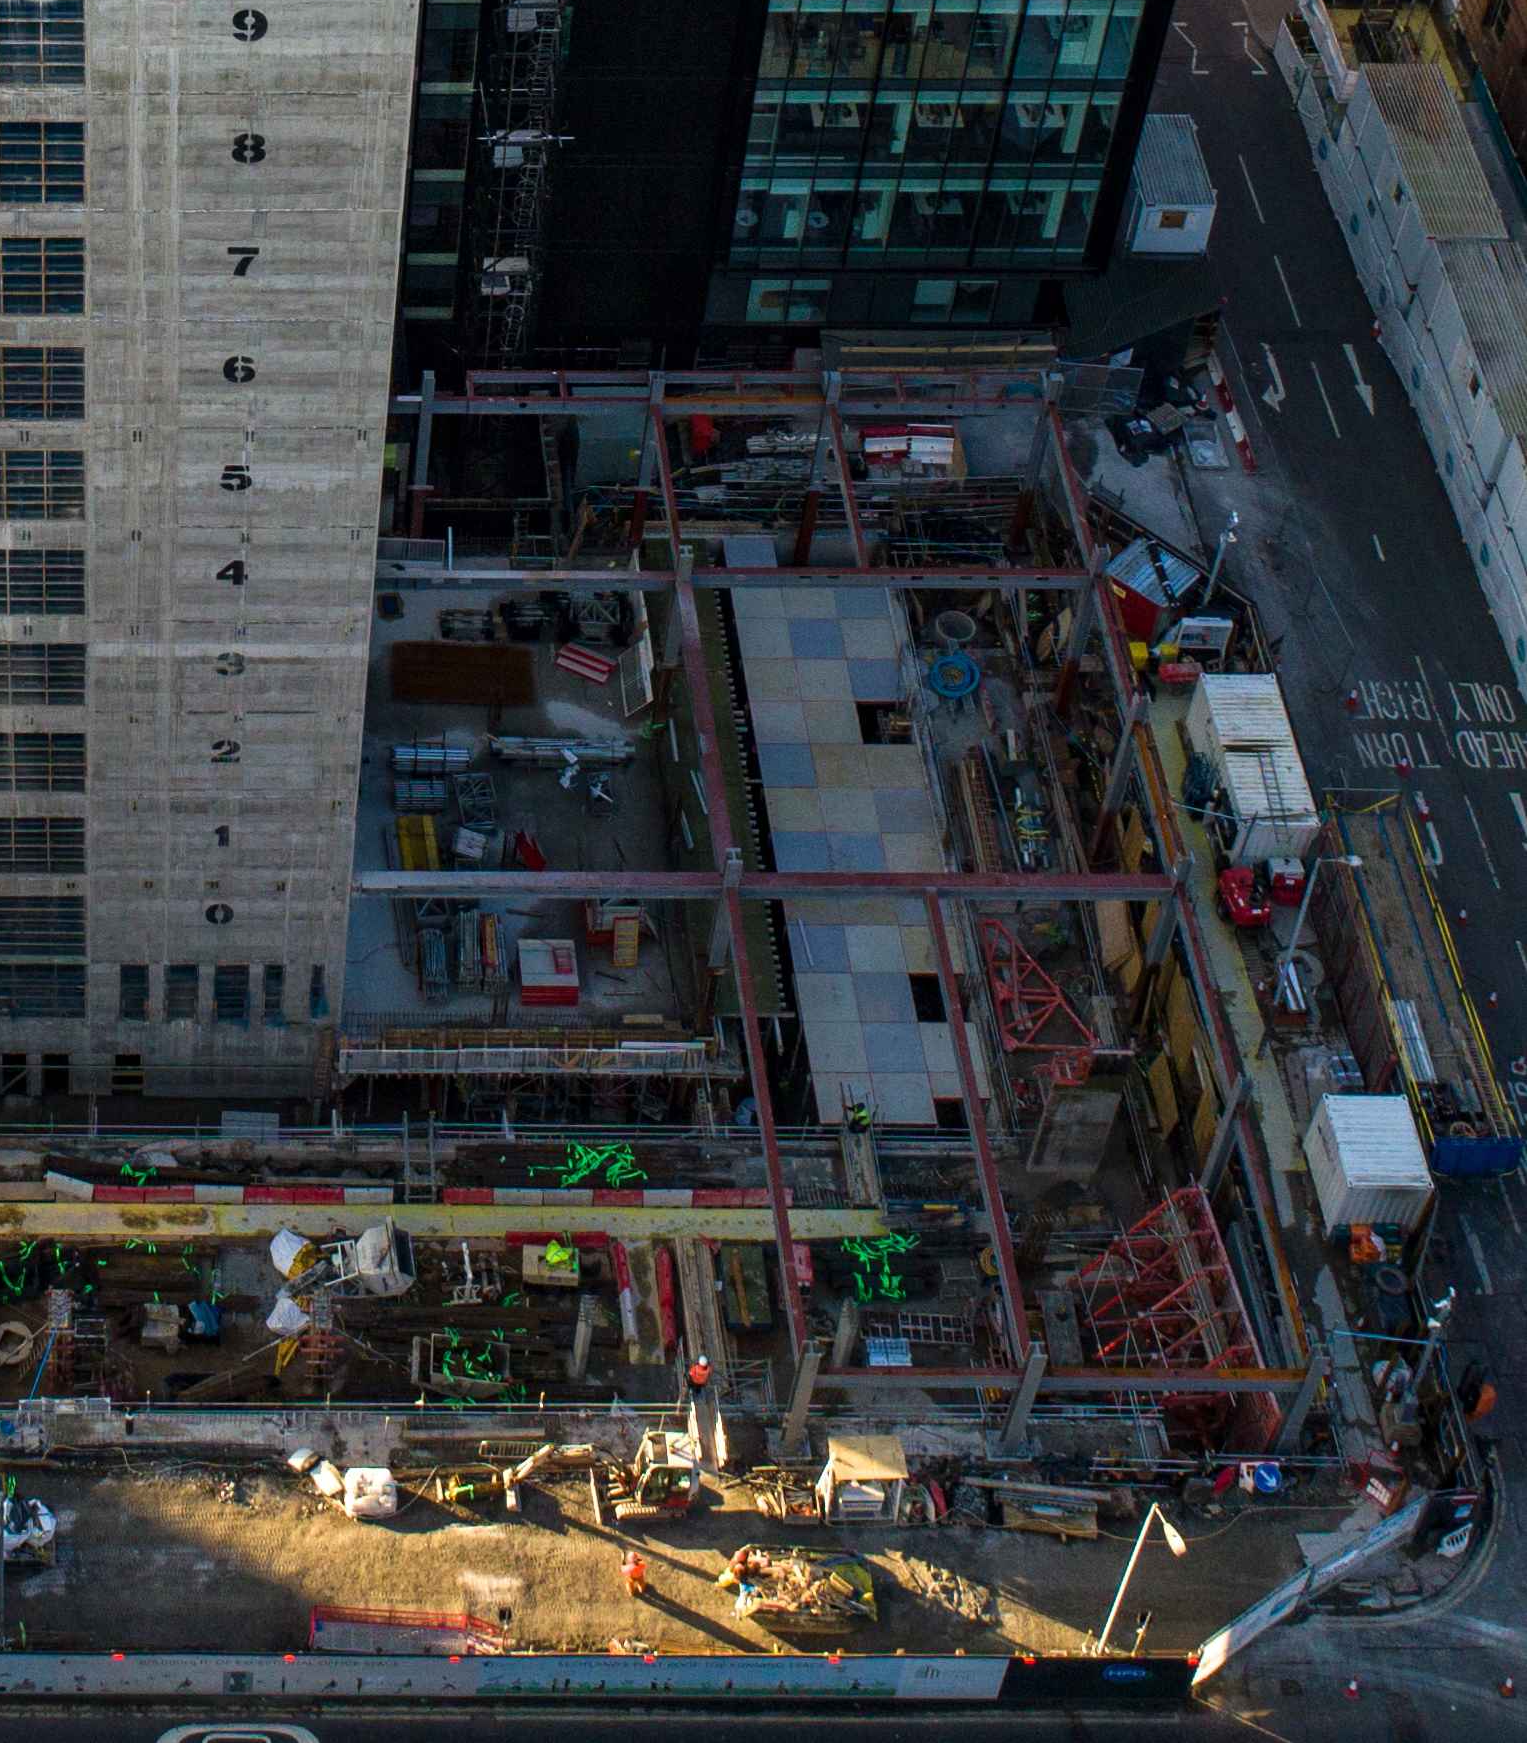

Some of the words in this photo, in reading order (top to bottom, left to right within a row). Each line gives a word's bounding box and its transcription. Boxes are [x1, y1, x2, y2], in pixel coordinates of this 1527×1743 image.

[232, 8, 269, 42] 9
[231, 133, 267, 164] 8
[227, 246, 260, 277] 7
[222, 356, 256, 384] 6
[219, 464, 253, 492] 5
[216, 560, 249, 586] 4
[216, 651, 246, 677] 3
[210, 739, 242, 764] 2
[214, 825, 231, 848] 1
[205, 903, 234, 926] 0
